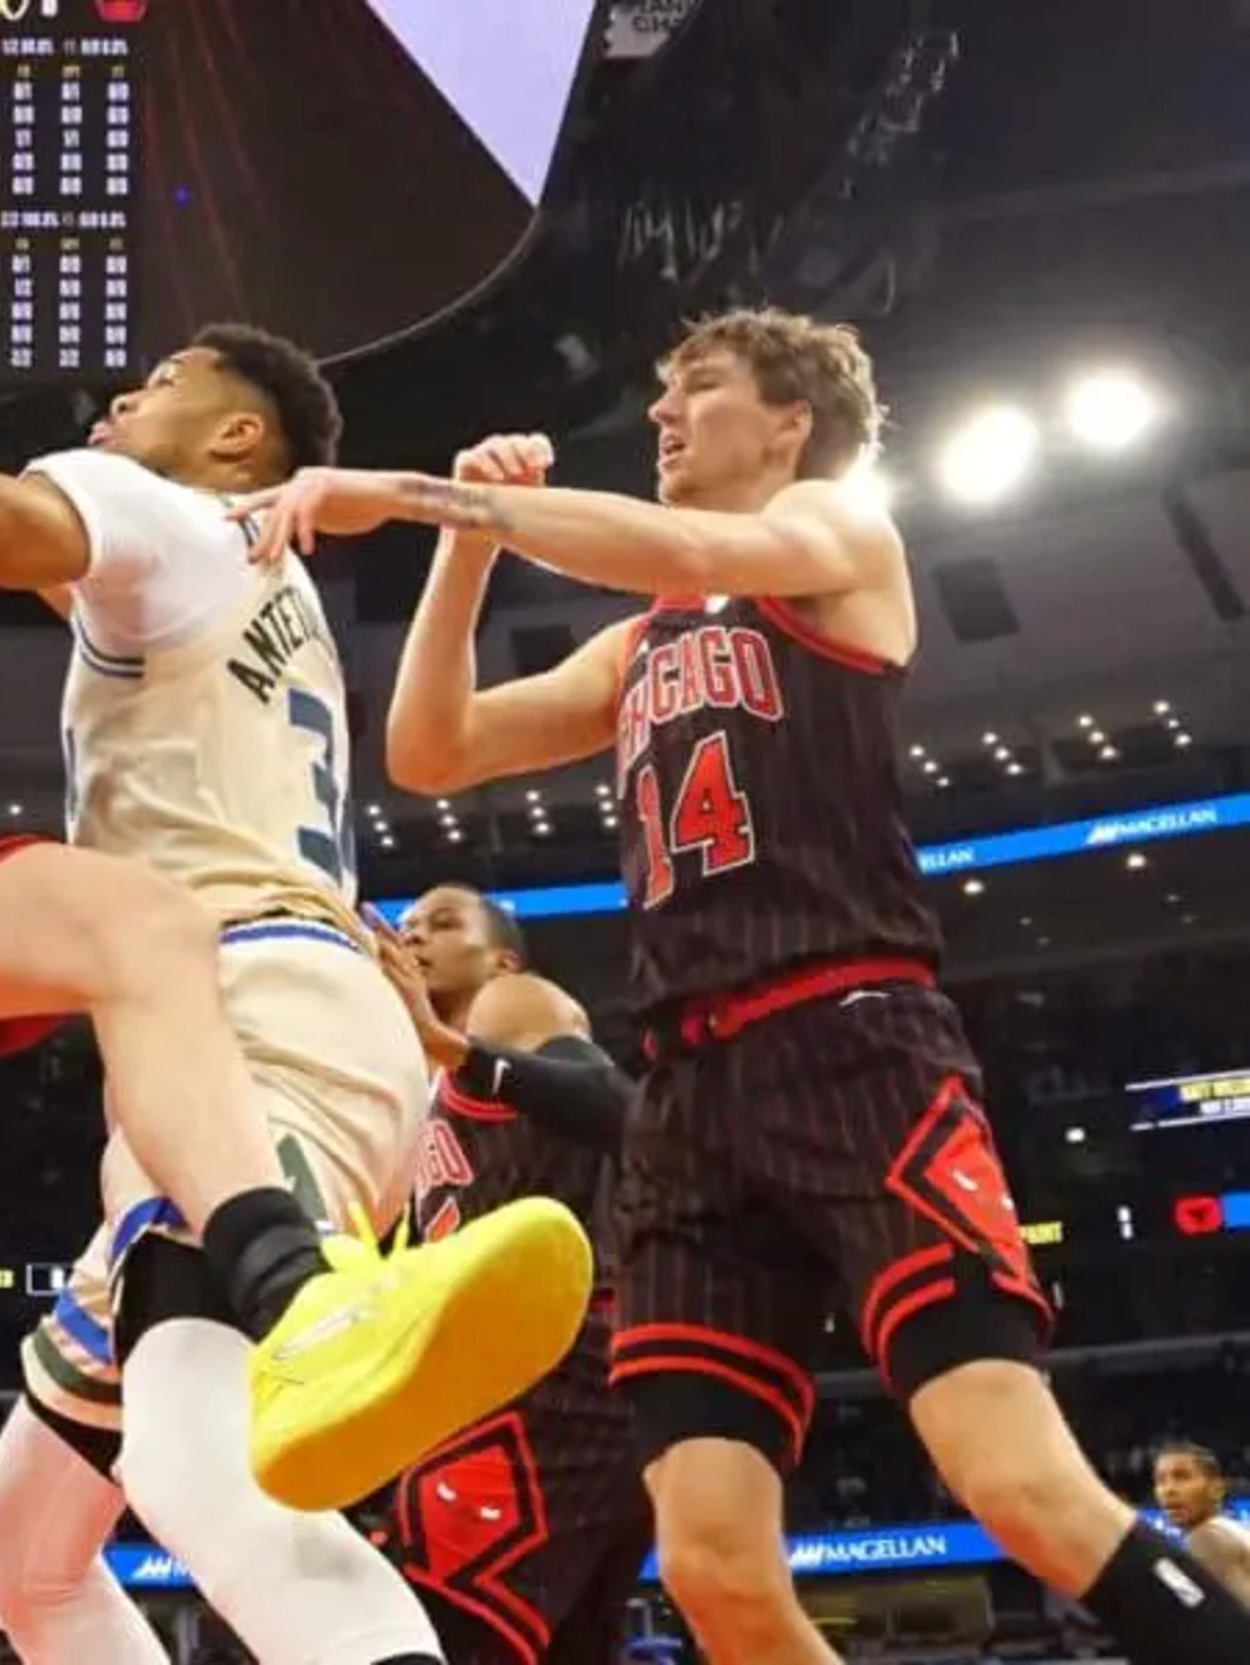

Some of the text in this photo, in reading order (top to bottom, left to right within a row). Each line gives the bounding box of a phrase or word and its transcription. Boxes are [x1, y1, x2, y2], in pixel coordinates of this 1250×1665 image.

[637, 729, 755, 910] 14
[1114, 801, 1218, 834] MAGELLAN
[828, 1536, 947, 1562] MAGELLAN
